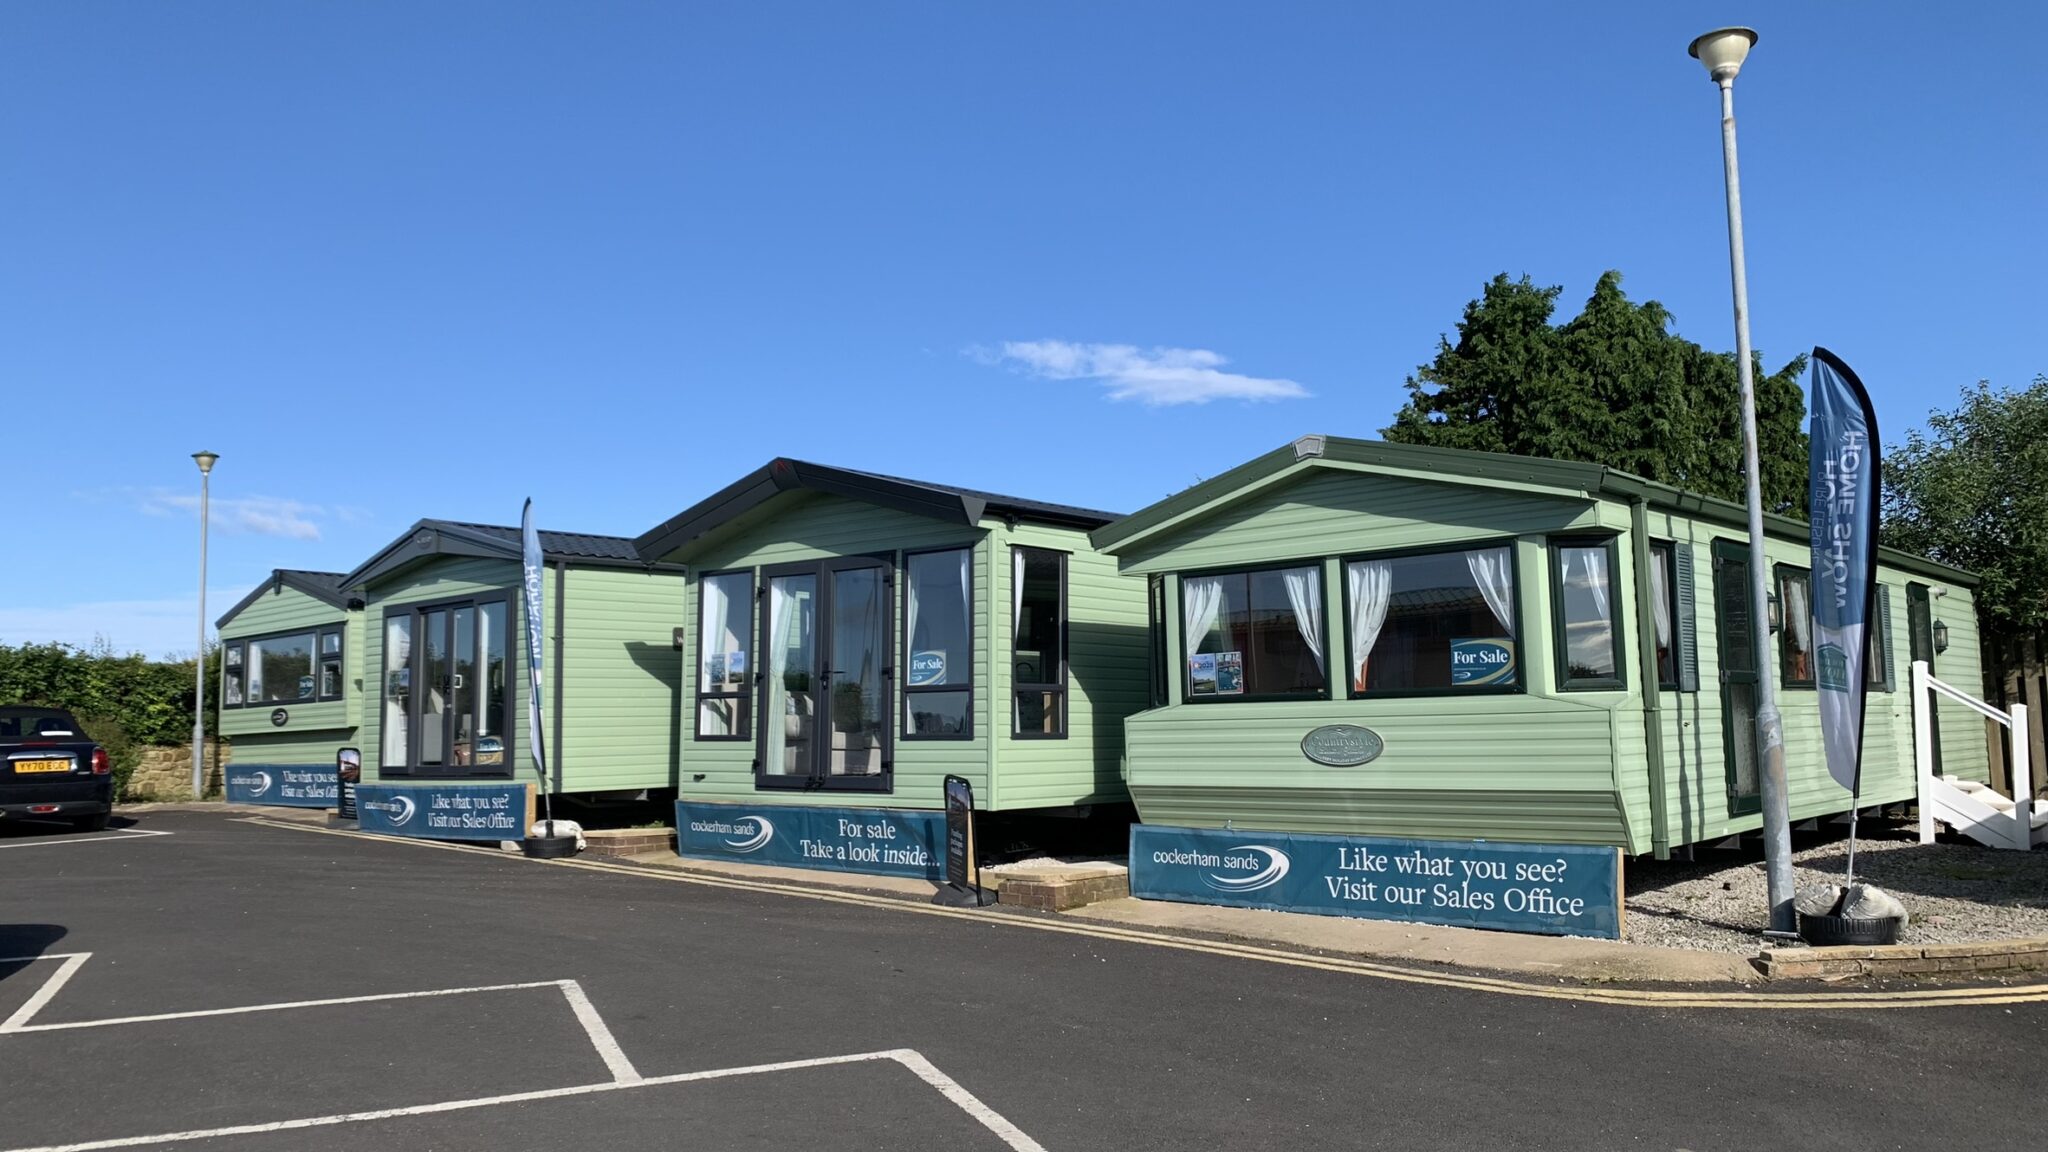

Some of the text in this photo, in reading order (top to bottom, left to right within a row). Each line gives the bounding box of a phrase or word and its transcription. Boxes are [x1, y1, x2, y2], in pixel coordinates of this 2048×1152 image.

[913, 657, 943, 670] For Sale
[1453, 648, 1508, 664] For Sale
[305, 784, 324, 798] Sales
[431, 793, 510, 812] Like what you see?
[427, 812, 448, 827] Visit
[462, 811, 487, 829] Sales
[487, 812, 515, 829] Office
[690, 818, 755, 835] cockerham sands
[838, 818, 896, 840] For sale
[800, 839, 833, 860] Take
[837, 846, 846, 860] a
[849, 842, 879, 863] look
[884, 844, 940, 867] inside...
[1153, 848, 1259, 871] cockerham sands
[1338, 847, 1567, 885] Like what you see?
[1324, 876, 1584, 917] Visit our Sales Office
